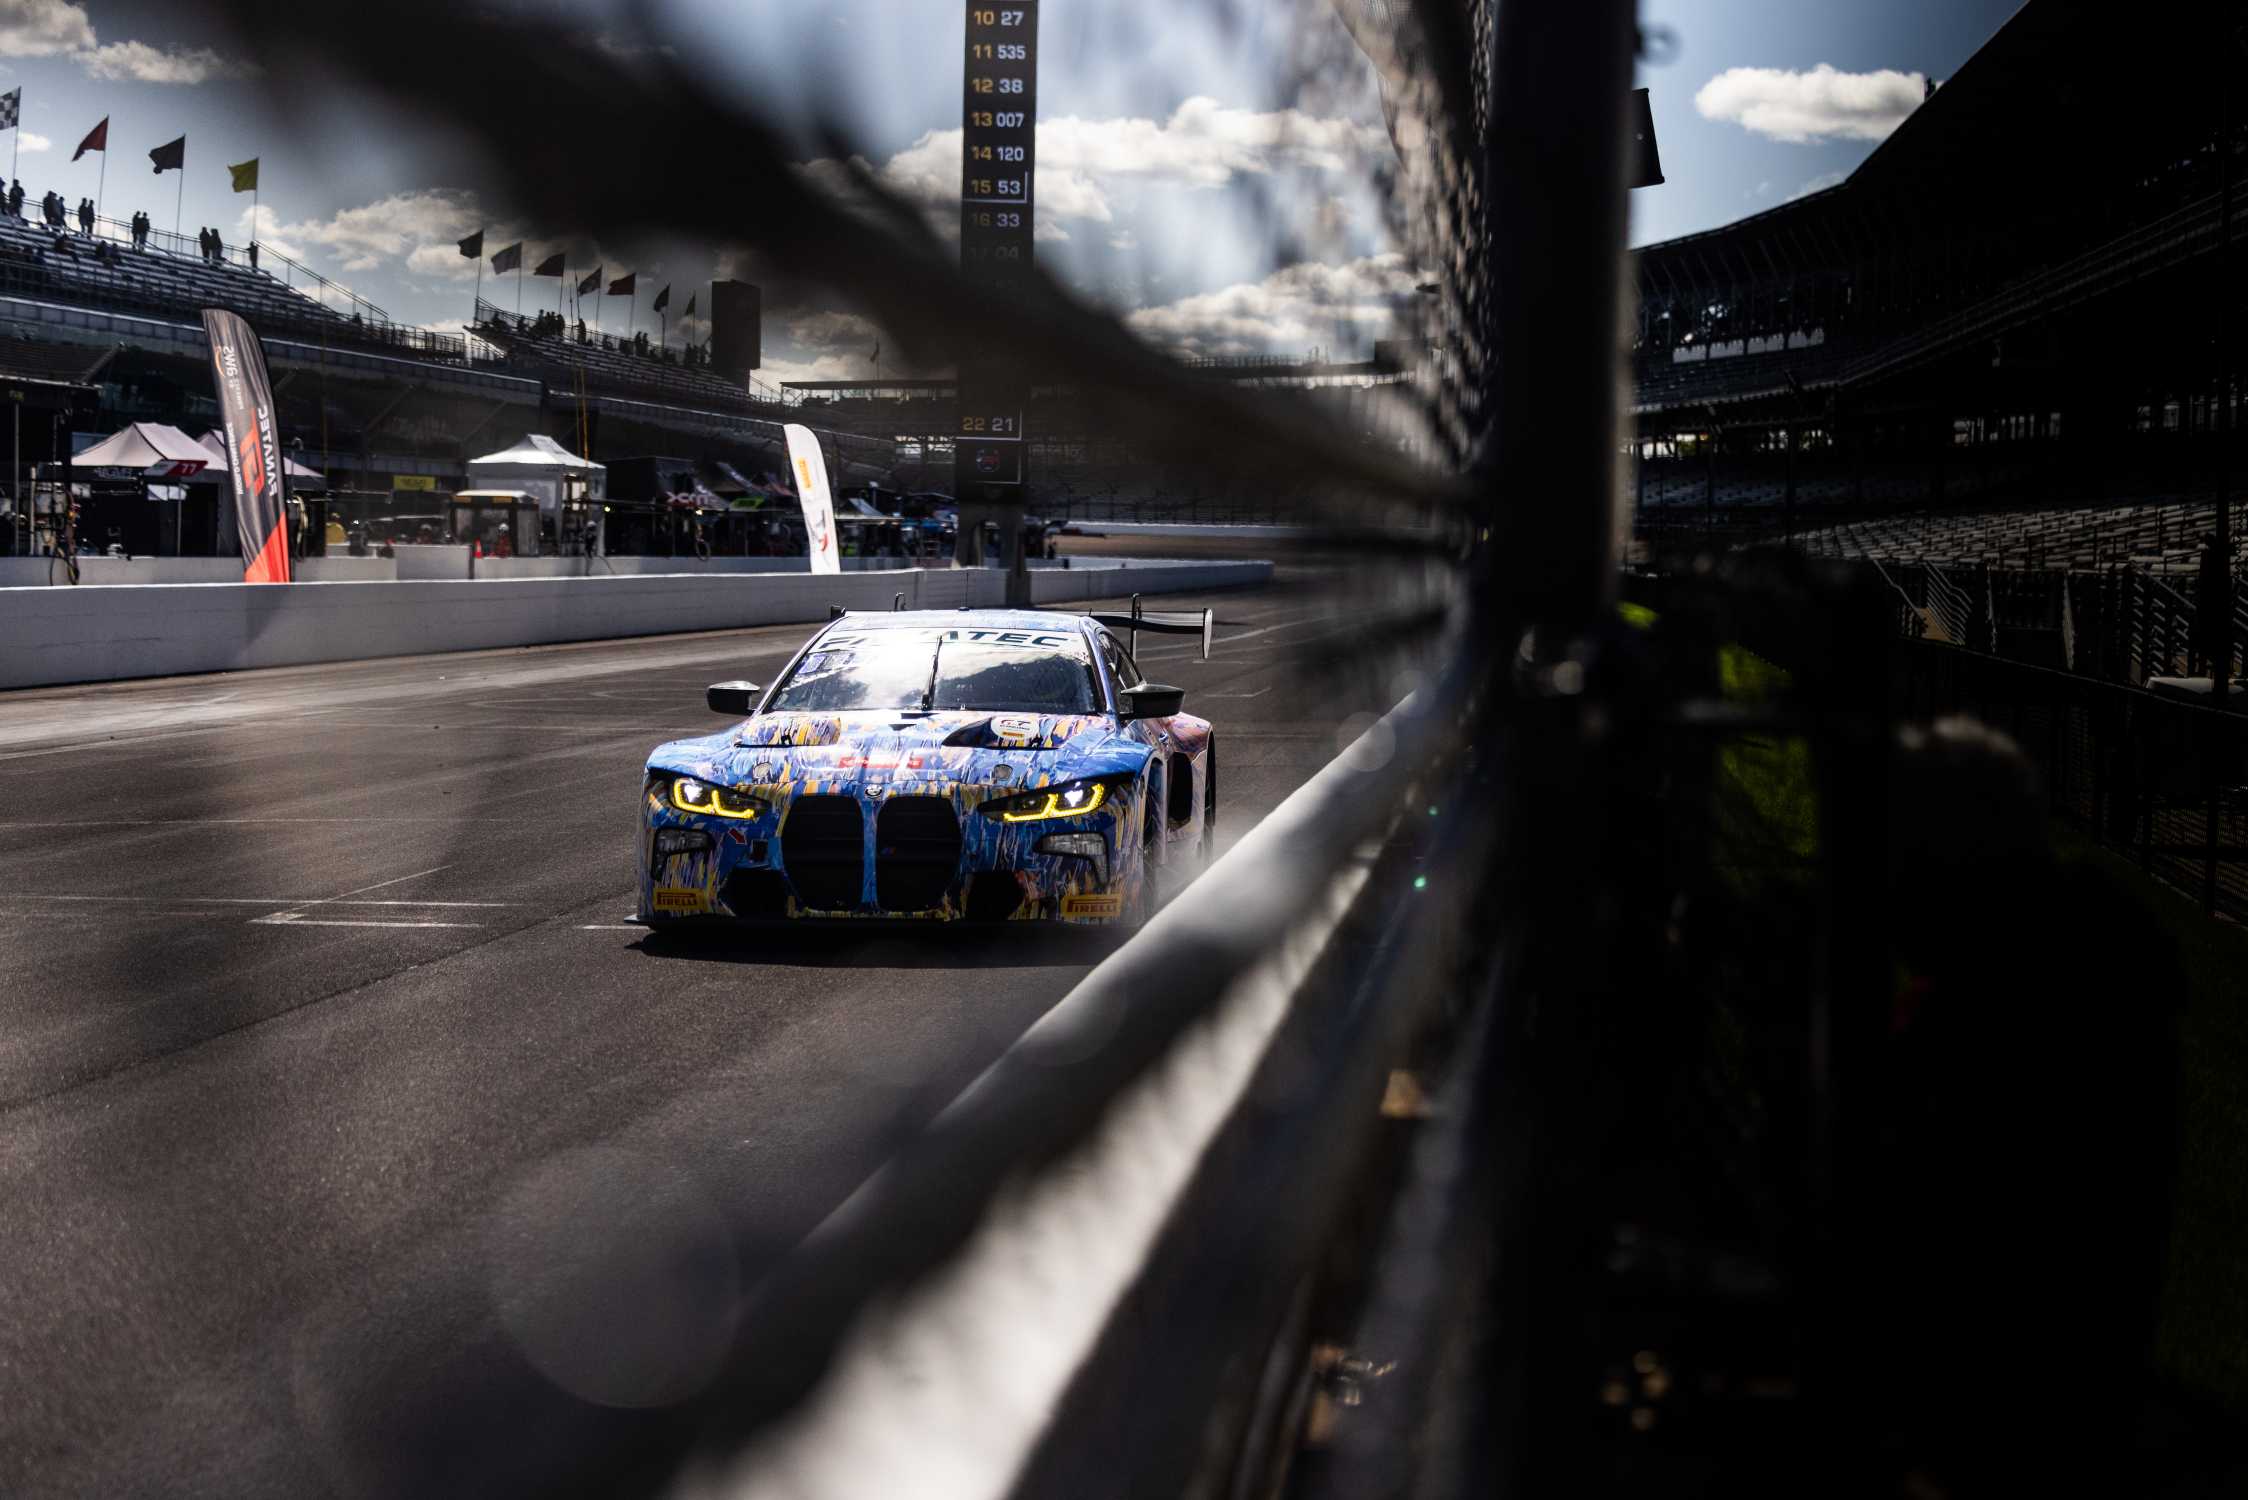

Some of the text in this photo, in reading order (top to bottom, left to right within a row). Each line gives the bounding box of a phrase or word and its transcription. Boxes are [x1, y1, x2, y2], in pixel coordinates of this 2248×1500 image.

[973, 11, 1024, 26] 10 27
[972, 44, 1026, 60] 11 535
[972, 79, 1024, 94] 12 38
[971, 112, 1024, 128] 13 007
[971, 146, 1024, 162] 14 120
[971, 180, 1021, 195] 15 53
[996, 213, 1020, 227] 33
[962, 417, 1013, 432] 22 21
[656, 892, 698, 906] PIRELLI
[1066, 898, 1118, 913] PIRELLI
